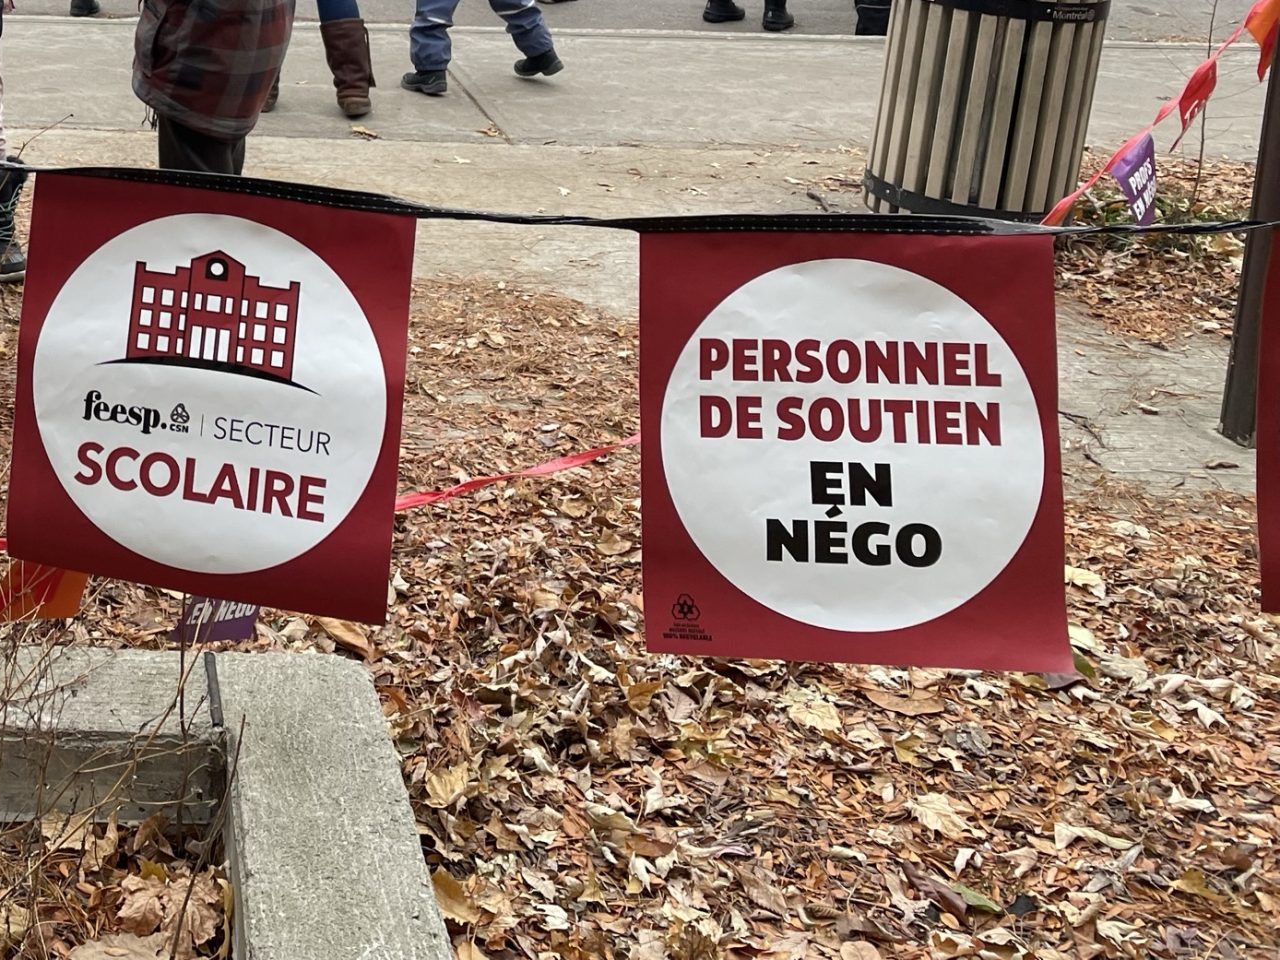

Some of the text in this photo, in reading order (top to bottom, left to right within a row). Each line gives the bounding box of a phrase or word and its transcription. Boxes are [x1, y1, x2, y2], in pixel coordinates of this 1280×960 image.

[1128, 157, 1153, 195] PROFS
[699, 338, 1002, 387] PERSONNEL
[213, 417, 331, 455] SECTEUR
[699, 395, 1002, 446] DE SOUTIEN
[74, 441, 327, 523] SCOLAIRE
[810, 460, 893, 507] EN
[766, 504, 942, 568] NÉGO
